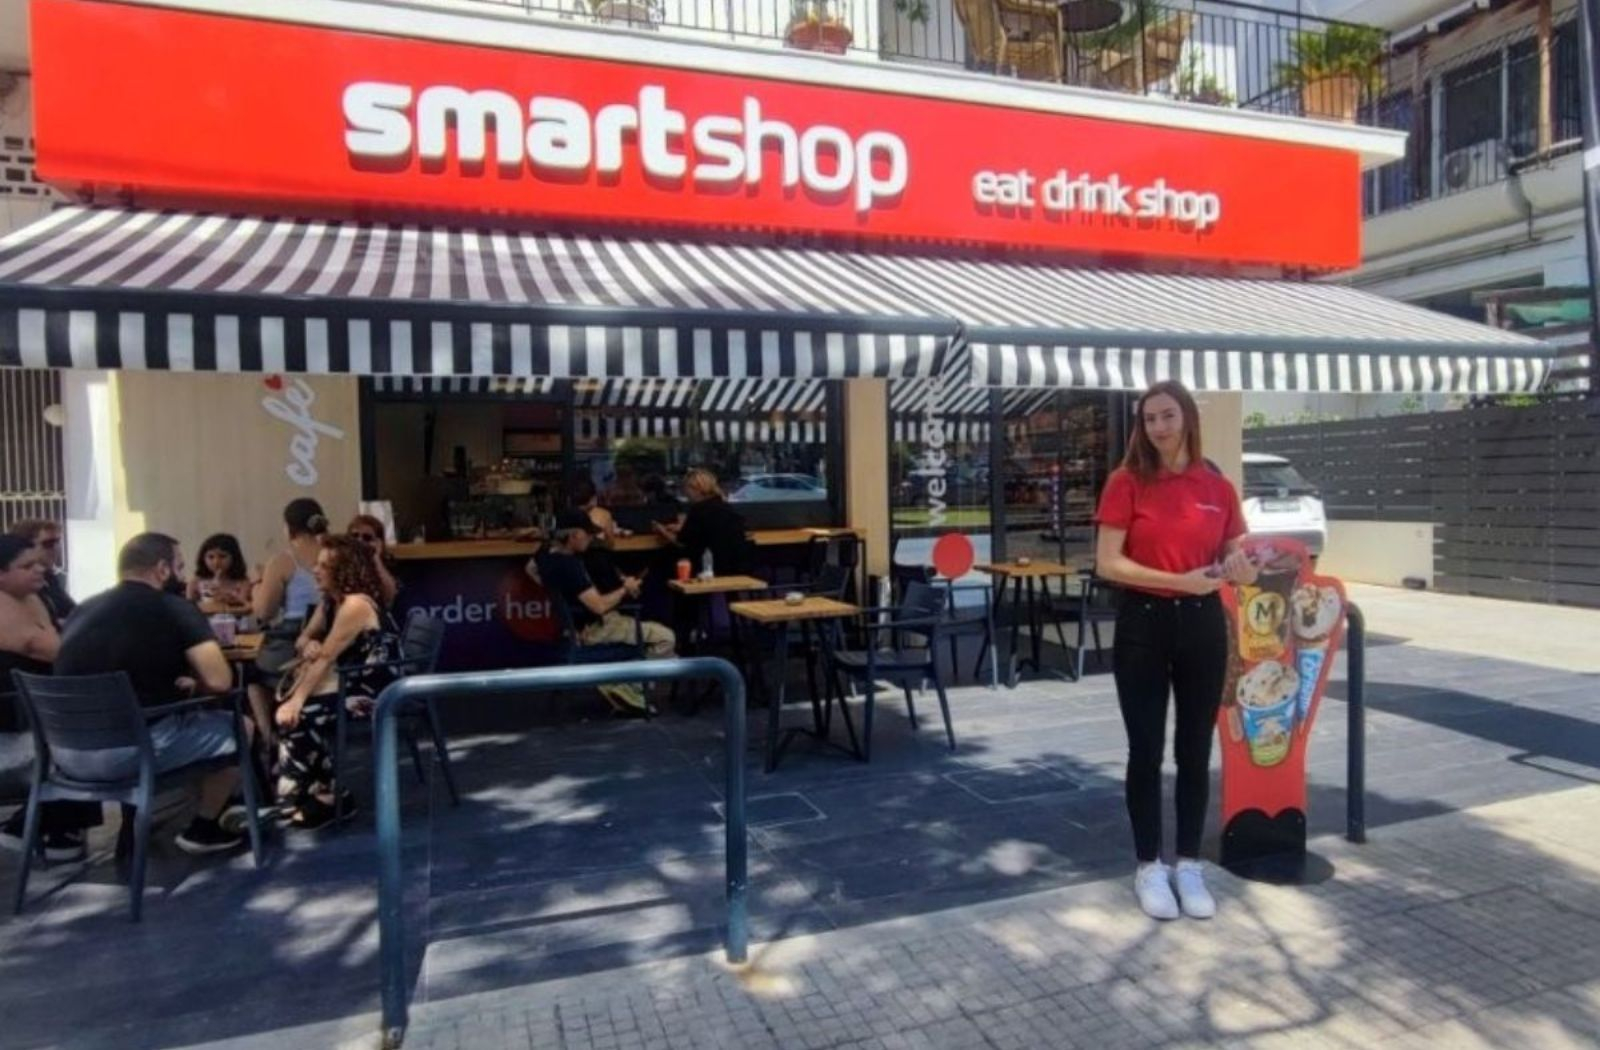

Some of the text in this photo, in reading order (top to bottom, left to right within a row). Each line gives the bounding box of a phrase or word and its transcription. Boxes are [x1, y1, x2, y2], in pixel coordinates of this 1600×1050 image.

[973, 168, 1220, 230] eat drink shop
